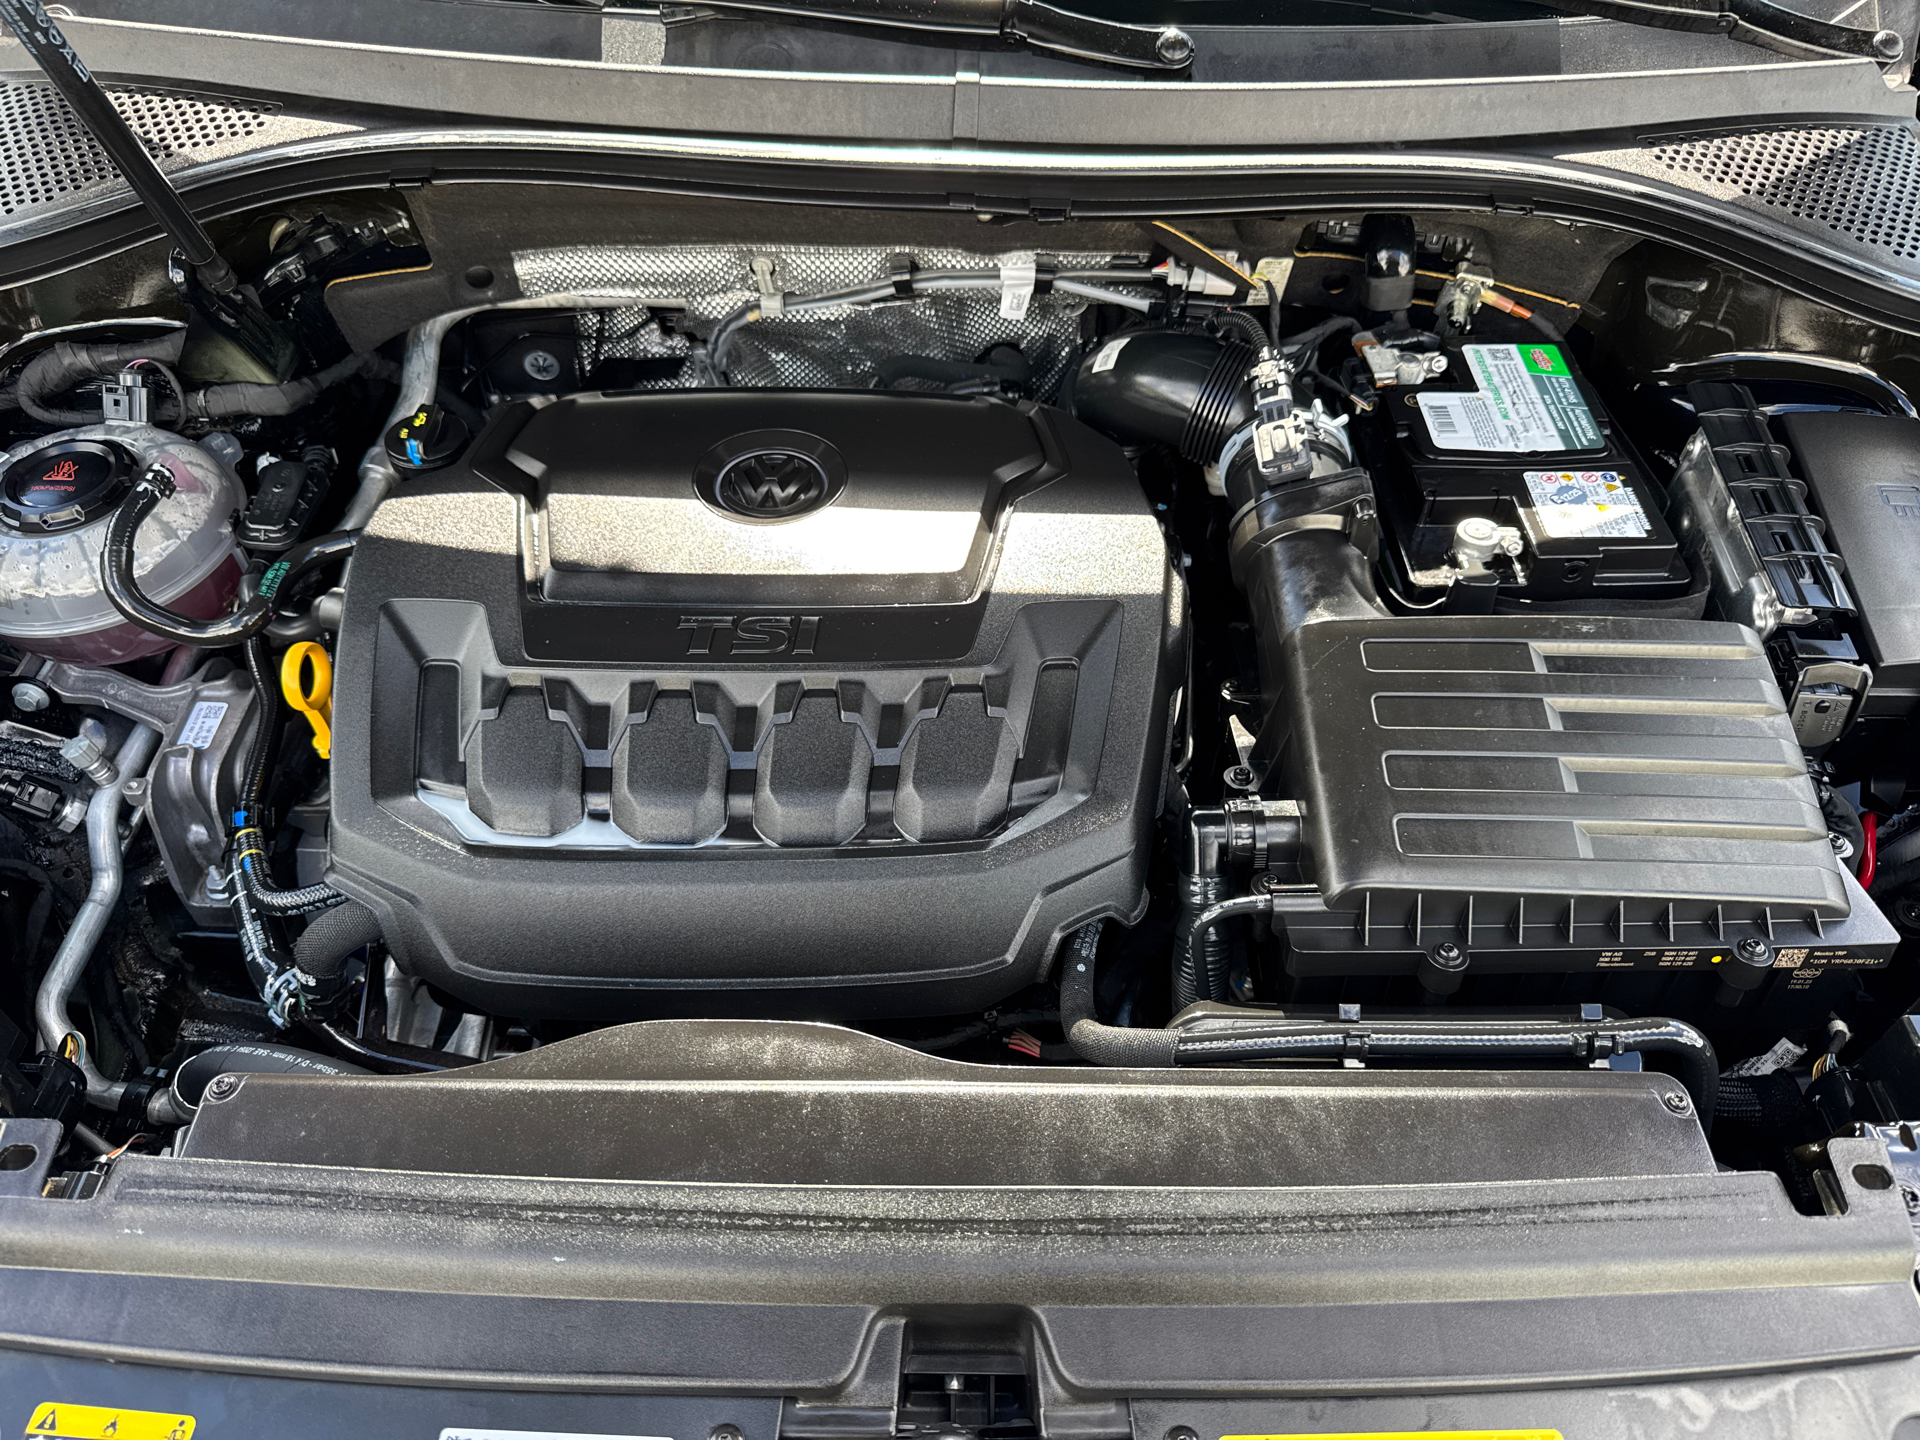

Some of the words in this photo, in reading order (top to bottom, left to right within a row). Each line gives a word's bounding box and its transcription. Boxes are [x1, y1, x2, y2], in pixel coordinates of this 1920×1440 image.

[1471, 348, 1510, 420] INTERSTATEBATTERIES.COM
[1574, 408, 1597, 440] AUTOMOTIVE
[677, 615, 823, 655] TSI
[1796, 710, 1809, 733] BOSCH
[252, 1047, 271, 1057] SAE
[312, 1062, 339, 1076] 35bar
